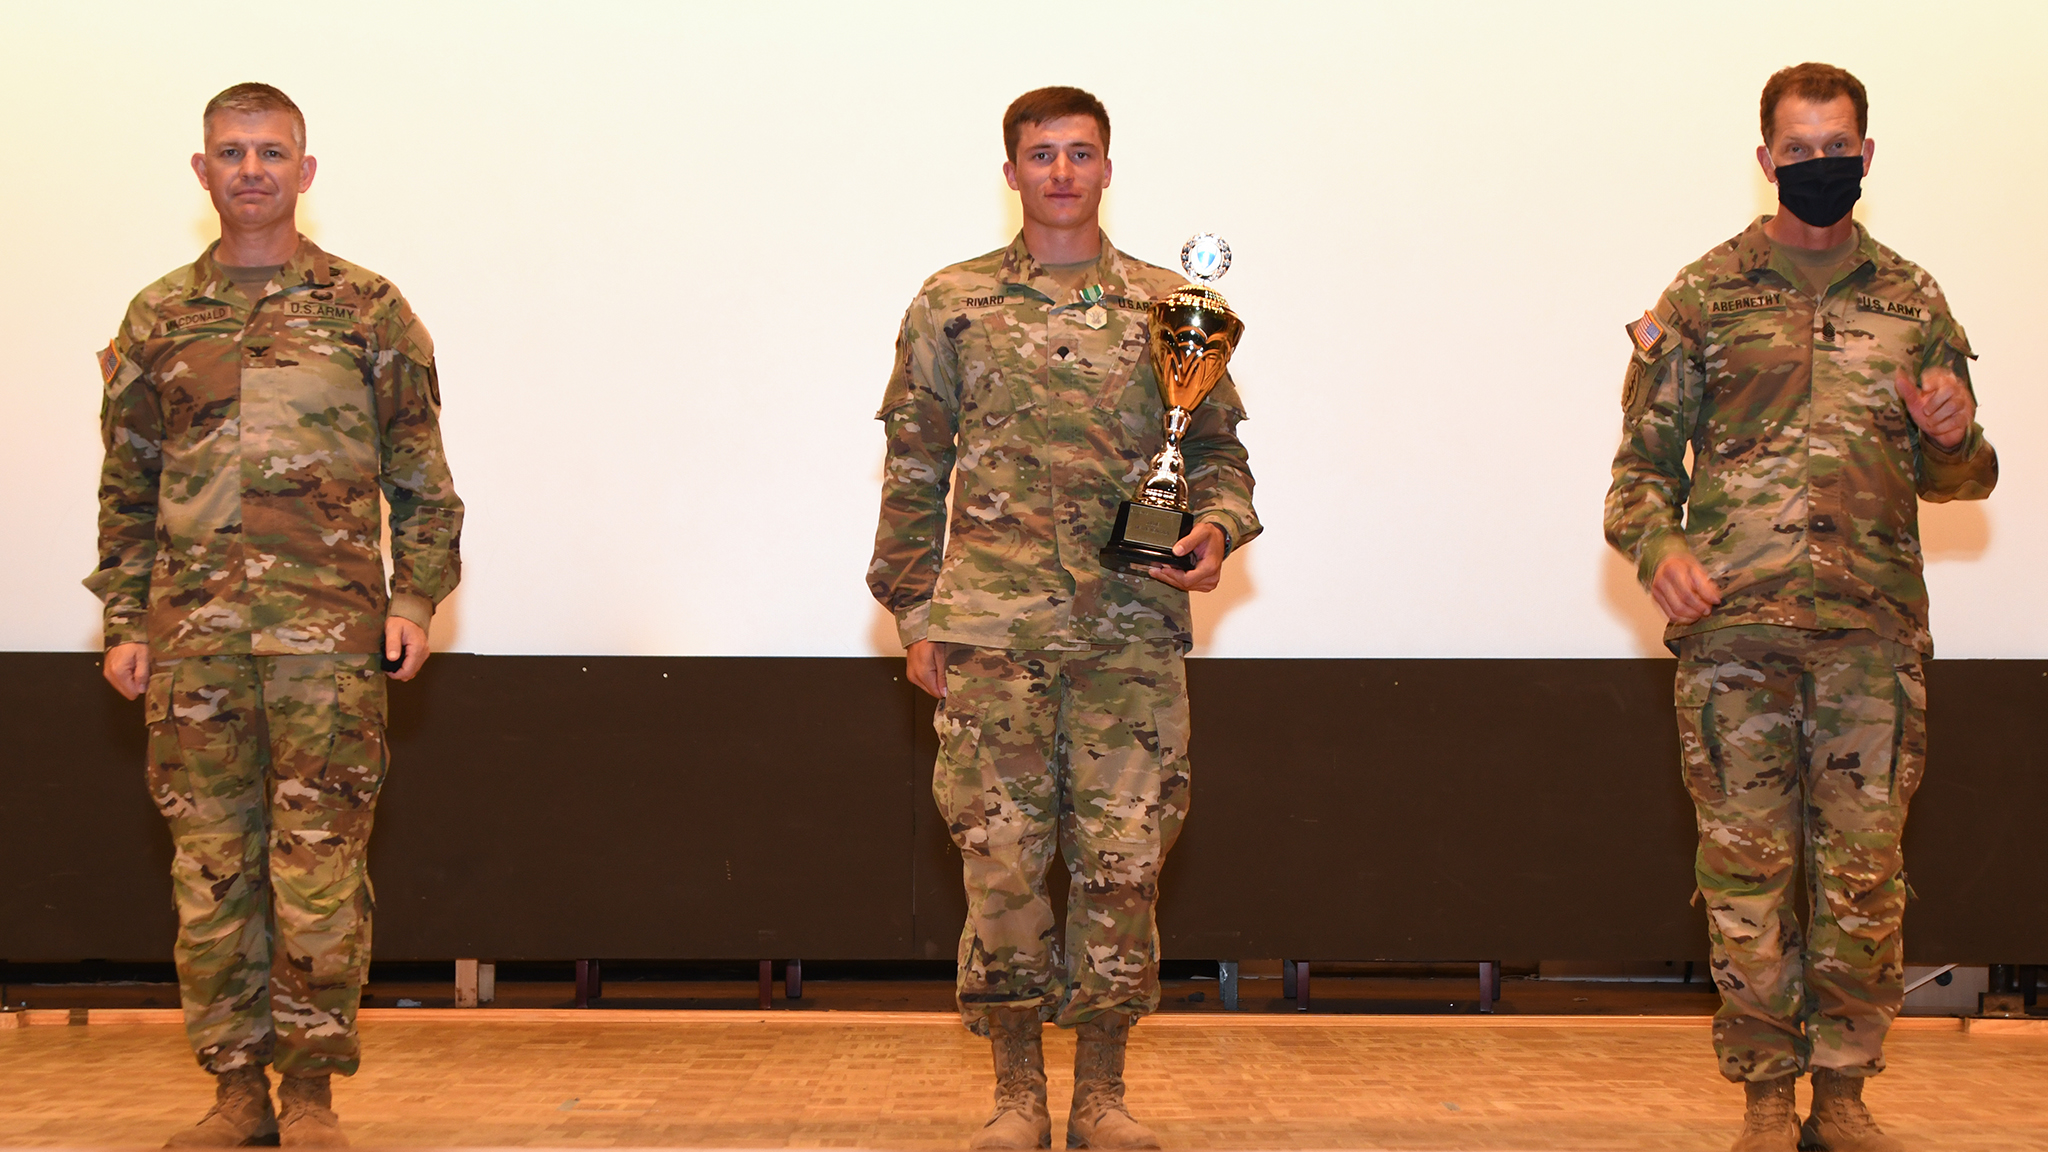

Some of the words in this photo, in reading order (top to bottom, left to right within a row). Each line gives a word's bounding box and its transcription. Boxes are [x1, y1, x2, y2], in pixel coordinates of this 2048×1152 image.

[966, 295, 1005, 307] RIVARD
[1712, 293, 1781, 312] ABERNETHY
[1887, 302, 1922, 318] ARMY
[165, 307, 226, 332] MACDONALD
